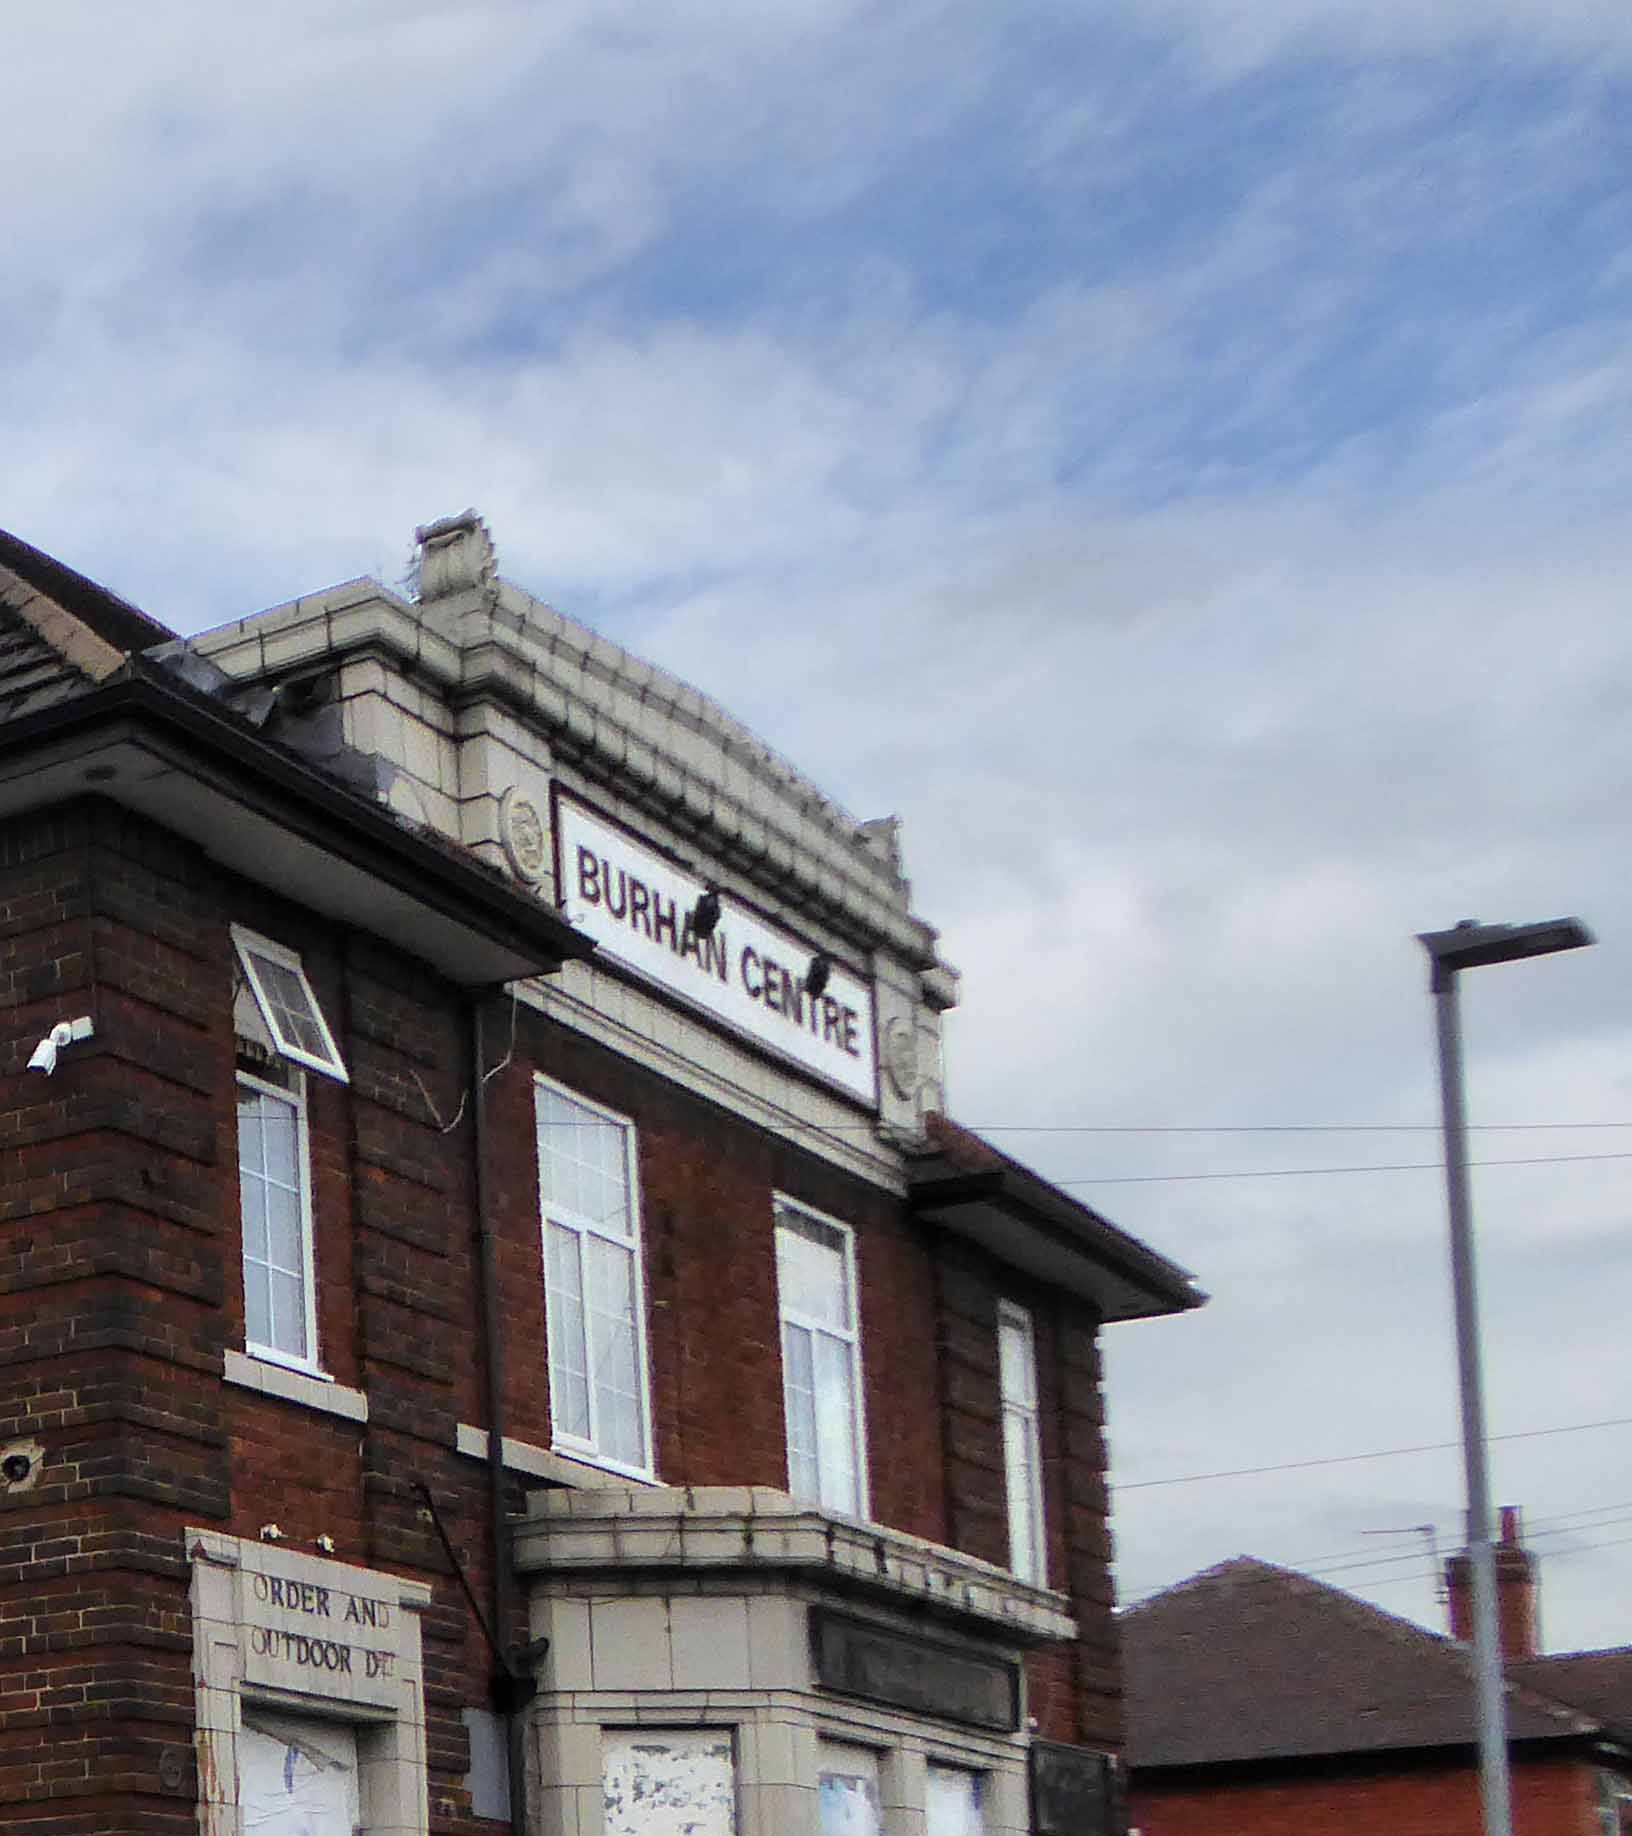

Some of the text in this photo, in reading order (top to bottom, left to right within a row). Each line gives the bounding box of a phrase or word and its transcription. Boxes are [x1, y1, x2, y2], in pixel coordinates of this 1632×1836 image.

[577, 845, 862, 1058] BURHAN CENTRE
[253, 1573, 391, 1629] ORDER AND
[251, 1625, 352, 1674] OUTDOOR
